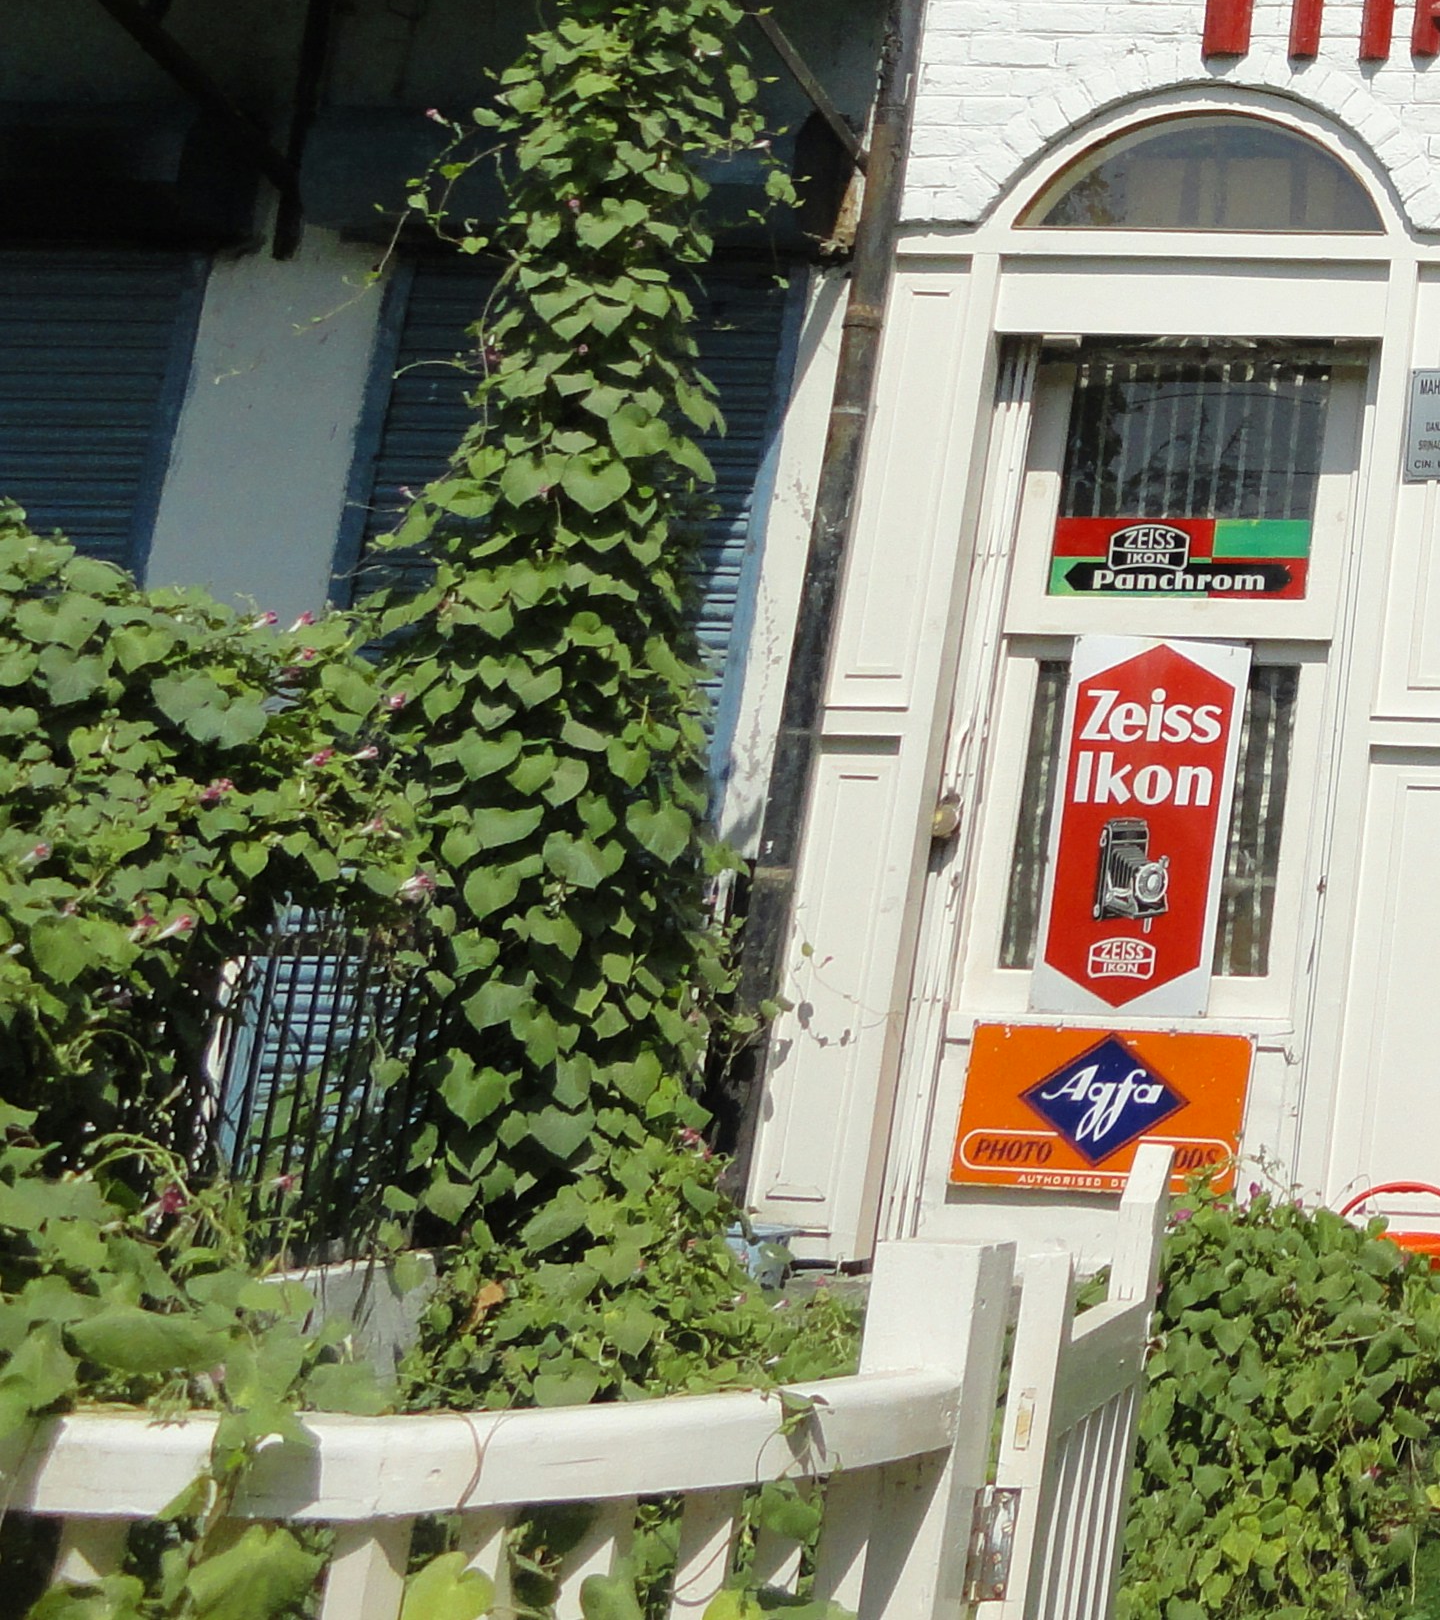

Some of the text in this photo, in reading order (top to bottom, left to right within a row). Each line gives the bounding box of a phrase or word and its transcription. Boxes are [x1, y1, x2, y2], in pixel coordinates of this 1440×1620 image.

[1414, 460, 1434, 469] CIN:
[1123, 528, 1176, 549] ZEISS
[1126, 552, 1170, 565] IKON
[1092, 569, 1265, 591] Panchrom
[1078, 687, 1223, 744] Zeiss
[1073, 750, 1214, 807] Ikon
[1100, 942, 1145, 960] ZEISS
[1102, 961, 1139, 974] IKON
[1040, 1064, 1165, 1142] Agfa
[971, 1137, 1220, 1171] PHOTO ODS
[1018, 1174, 1102, 1187] AUTHORISED
